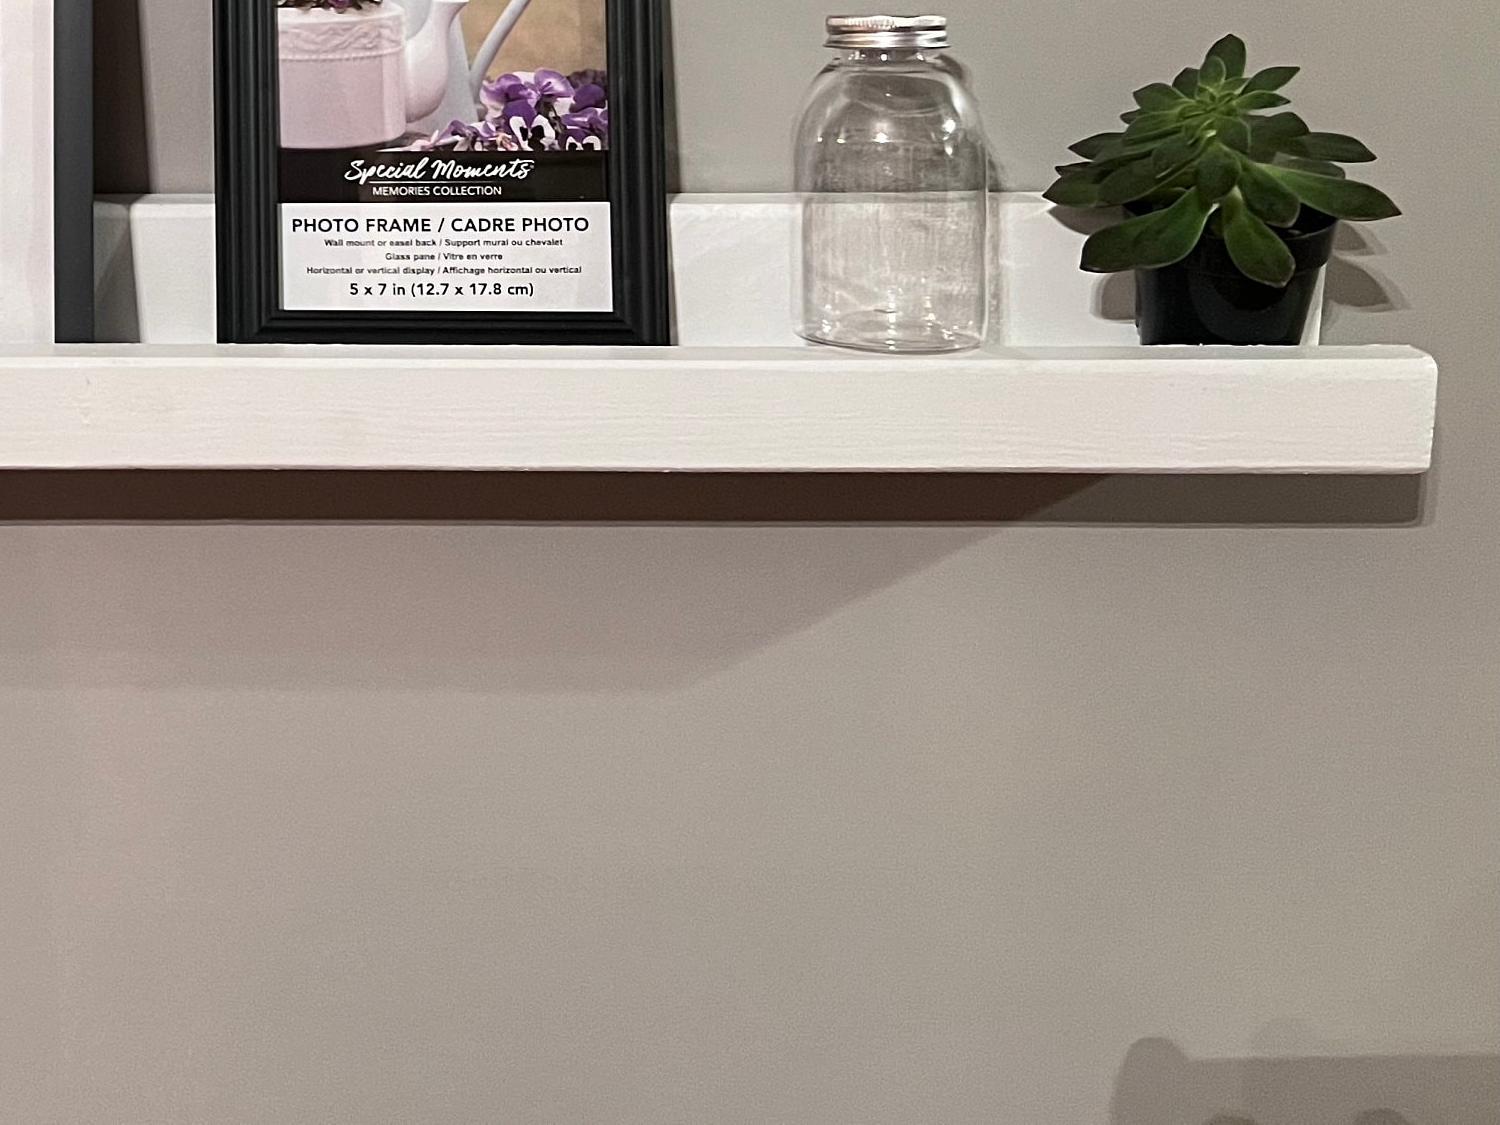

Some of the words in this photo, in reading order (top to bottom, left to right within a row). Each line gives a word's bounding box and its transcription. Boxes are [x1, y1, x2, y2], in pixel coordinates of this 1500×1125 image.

[344, 156, 430, 184] Special
[430, 159, 534, 179] Moments
[372, 186, 431, 196] MEMORIES
[433, 185, 502, 196] COLLECTION
[292, 218, 359, 233] PHOTO
[366, 218, 431, 232] FRAME
[437, 218, 445, 232] /
[451, 218, 515, 232] CADRE
[522, 217, 589, 232] PHOTO
[389, 238, 413, 246] easel
[415, 238, 437, 246] back
[439, 238, 443, 247] /
[444, 238, 480, 249] Support
[483, 238, 508, 246] mural
[526, 238, 563, 246] chevalet
[413, 254, 436, 263] pane
[437, 252, 442, 261] /
[443, 252, 464, 260] Vitre
[306, 267, 353, 275] Horizontal
[403, 266, 435, 277] display
[437, 266, 442, 275] /
[443, 266, 485, 276] Affichage
[488, 266, 533, 274] horizontal
[549, 266, 582, 274] vertical
[350, 284, 358, 296] 5
[364, 286, 372, 296] x
[378, 284, 387, 296] 7
[393, 283, 406, 295] in
[410, 282, 450, 299] (12.7
[455, 286, 463, 295] x
[468, 283, 502, 295] 17.8
[507, 282, 534, 298] cm)
